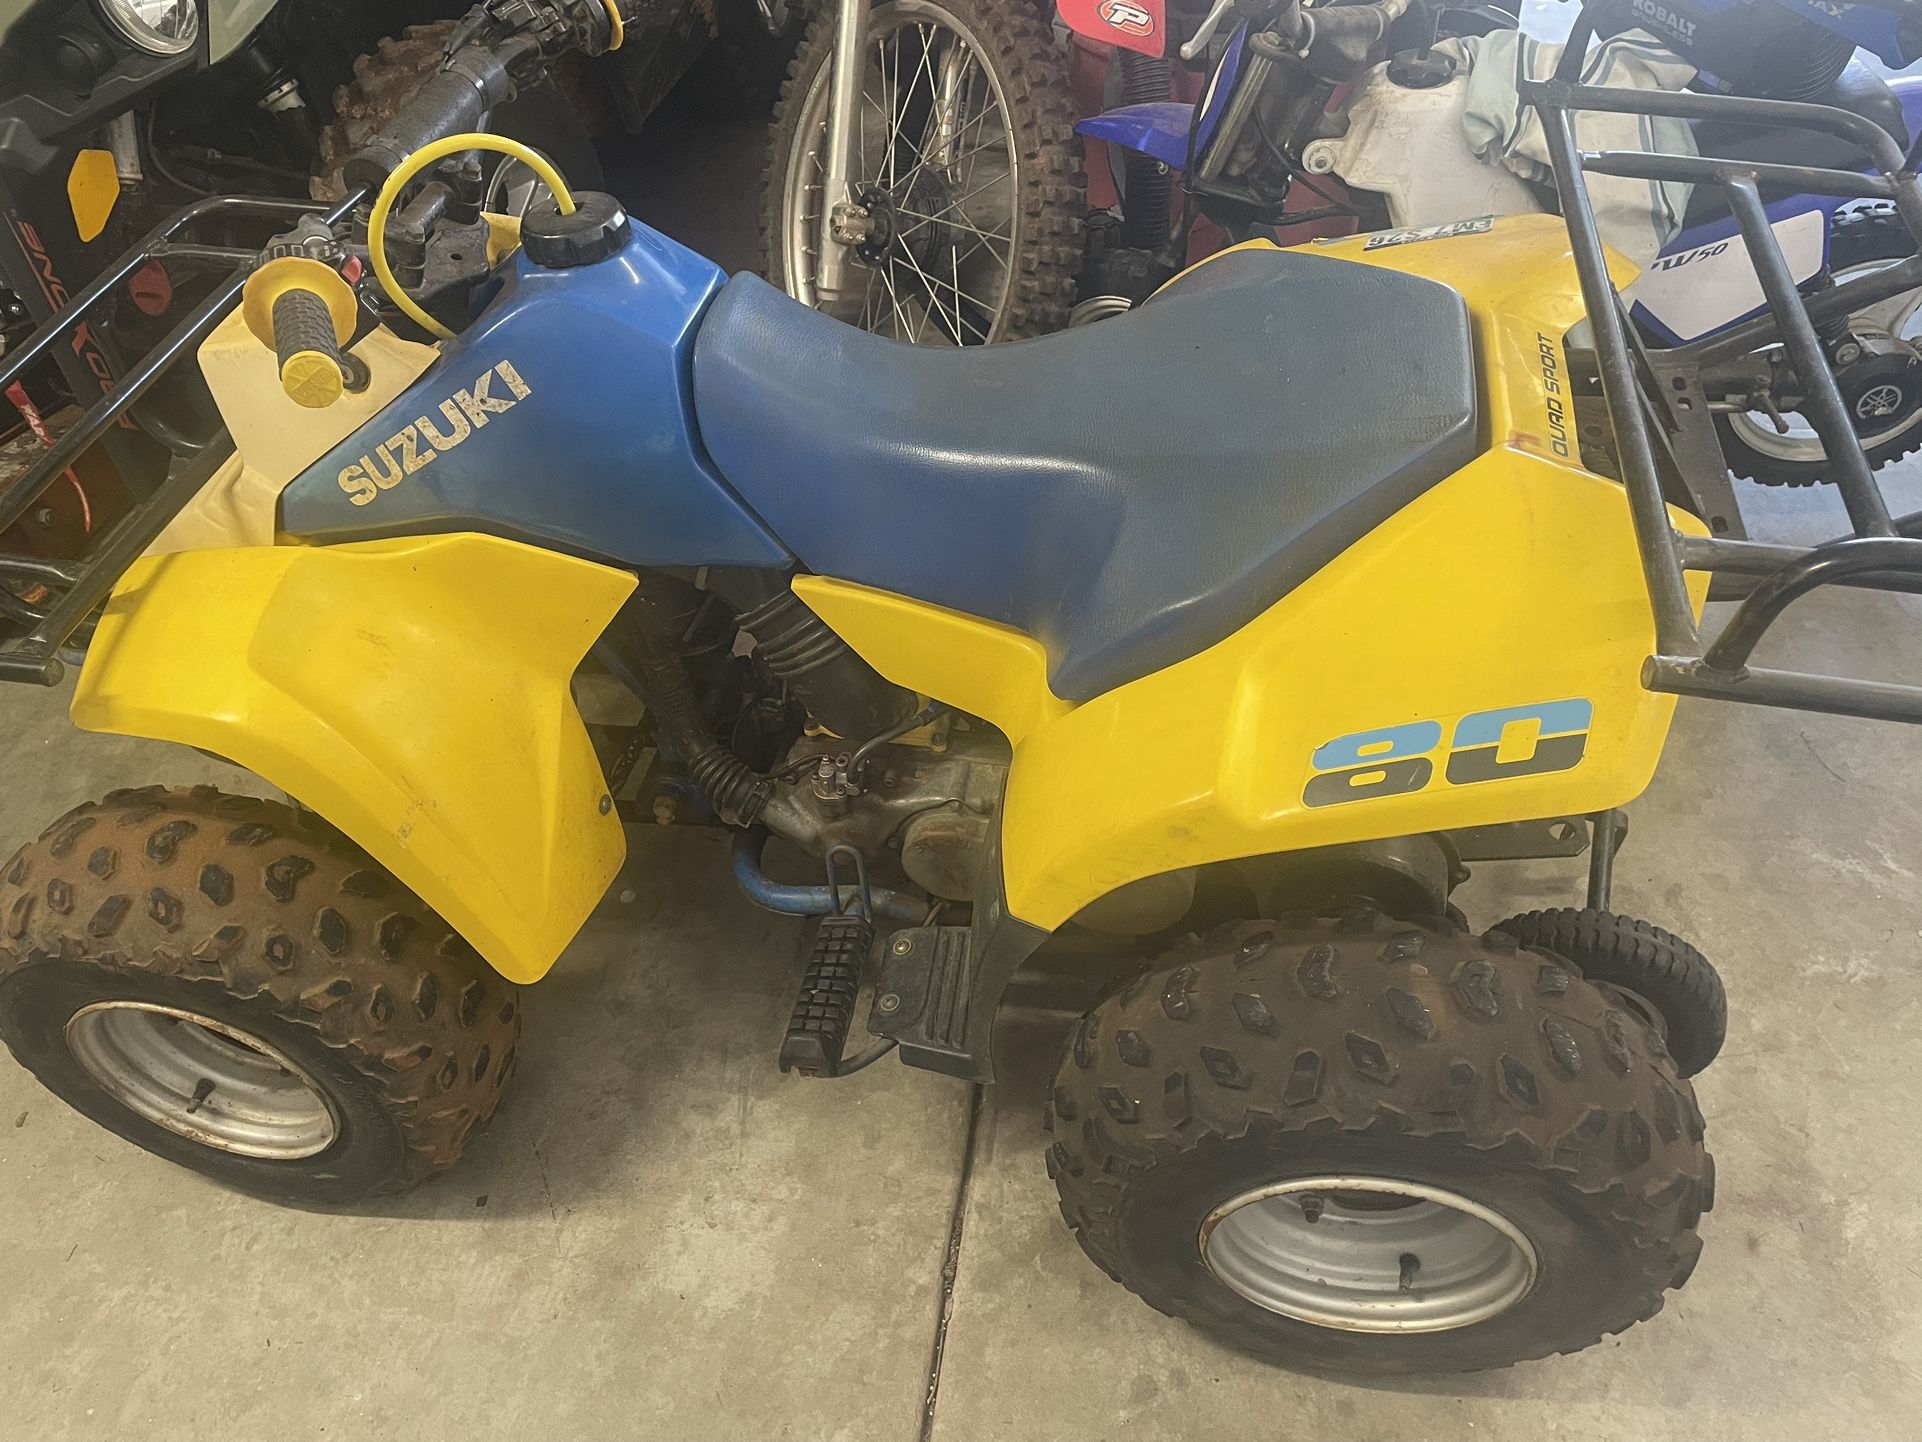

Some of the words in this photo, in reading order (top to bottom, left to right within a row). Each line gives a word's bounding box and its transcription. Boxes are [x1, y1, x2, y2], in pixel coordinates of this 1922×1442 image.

[1632, 0, 1697, 37] KOBALT
[1651, 242, 1728, 271] W50
[1537, 332, 1560, 394] SPORT
[338, 359, 532, 506] SUZUKI
[1547, 397, 1568, 457] QUAD
[1301, 697, 1594, 809] 80
